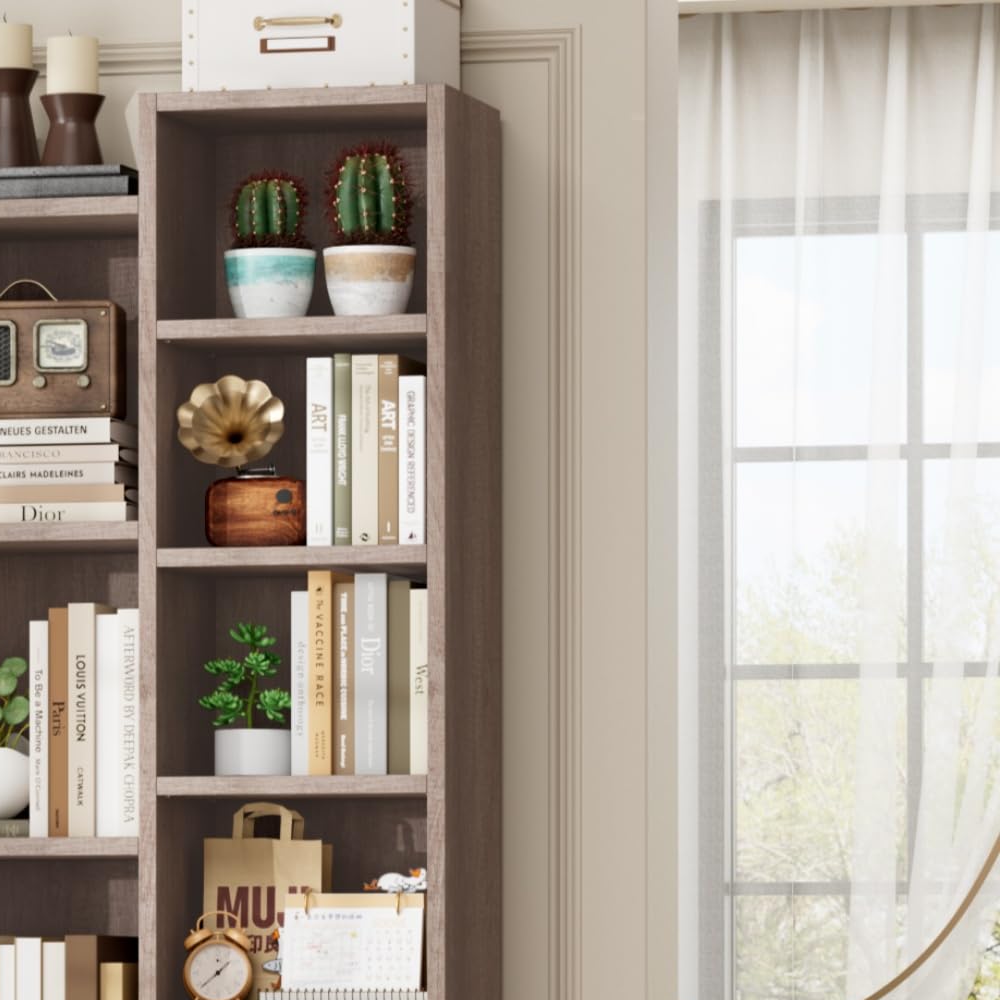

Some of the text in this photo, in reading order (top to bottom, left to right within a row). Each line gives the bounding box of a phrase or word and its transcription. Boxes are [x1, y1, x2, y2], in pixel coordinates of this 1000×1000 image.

[0, 427, 32, 436] NEUES
[34, 425, 87, 435] GESTALTEN
[311, 403, 327, 432] ART
[381, 400, 396, 430] ART
[30, 469, 84, 479] MADELEINES
[21, 505, 66, 522] Dior
[315, 614, 324, 668] VACCINE
[361, 637, 381, 675] Dior
[35, 670, 43, 681] To
[35, 684, 43, 697] Be
[315, 675, 324, 707] RACE
[415, 664, 428, 695] West
[76, 655, 86, 742] LOUIS VUITTON
[35, 710, 44, 753] Machine
[52, 701, 65, 736] Paris
[123, 626, 135, 823] AFTERWORD BY DEEPAK CHOPRA
